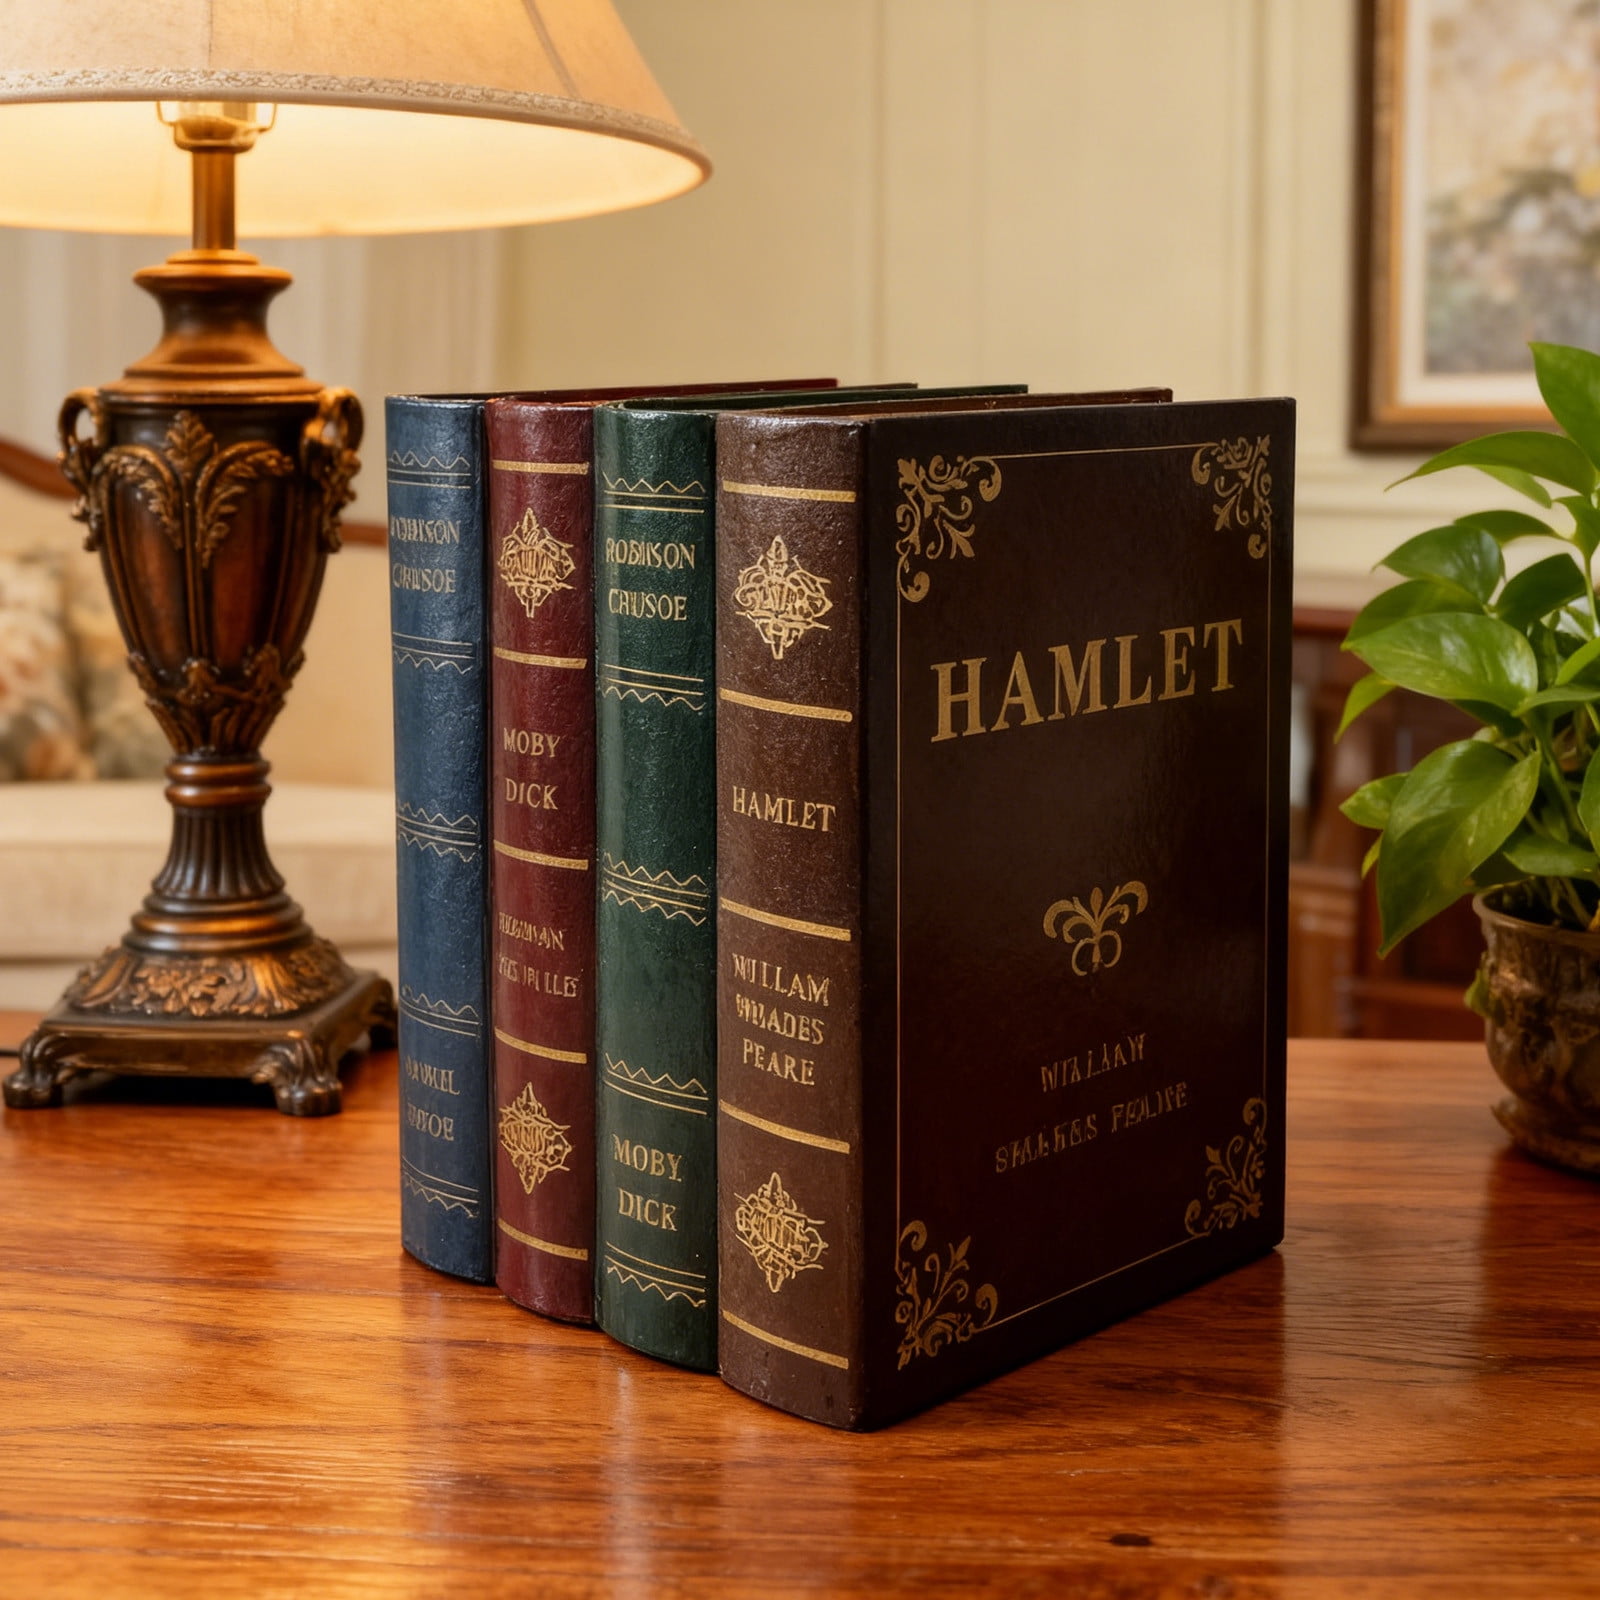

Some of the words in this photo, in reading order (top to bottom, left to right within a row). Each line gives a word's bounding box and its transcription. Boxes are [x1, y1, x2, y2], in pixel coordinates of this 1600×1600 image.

[931, 618, 1243, 743] HAMLET
[503, 727, 560, 757] MOBY
[505, 777, 559, 810] DICK
[732, 785, 837, 832] HAMLET
[611, 1133, 683, 1182] MOBY
[618, 1187, 678, 1232] DICK
